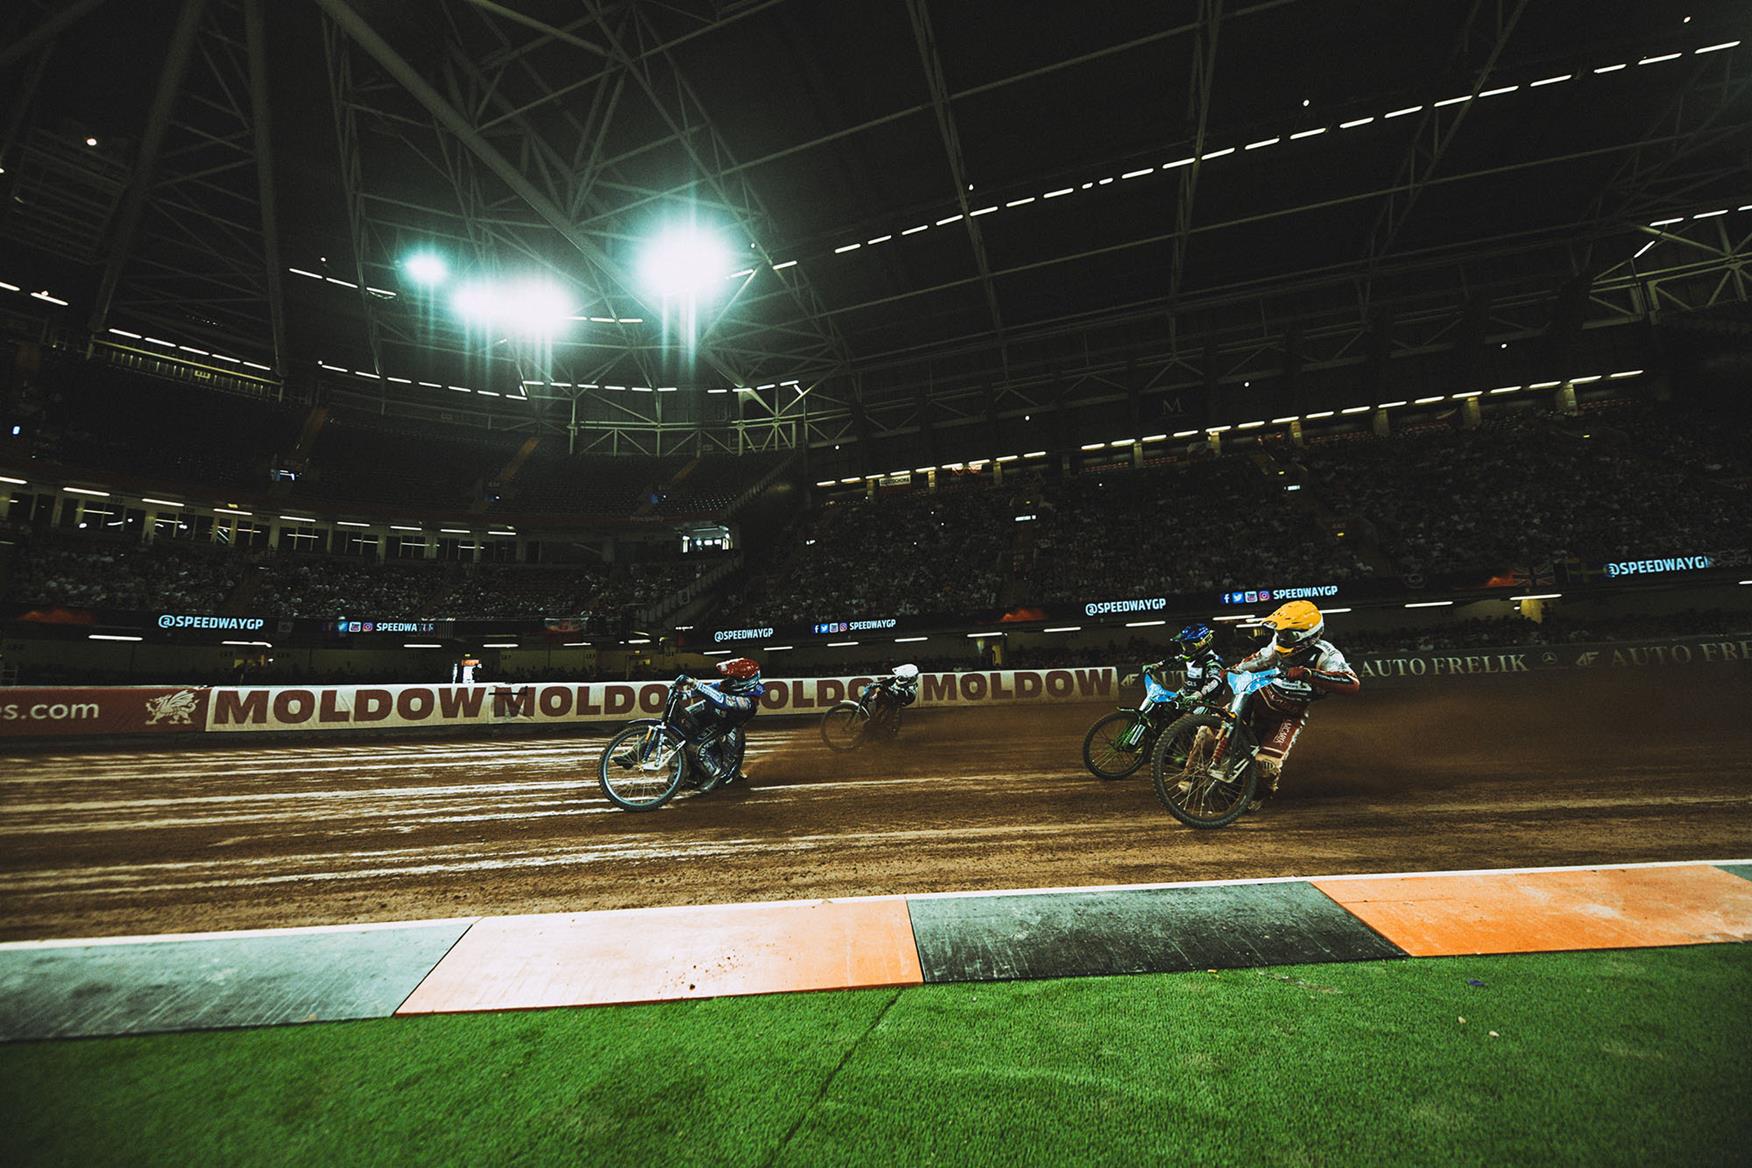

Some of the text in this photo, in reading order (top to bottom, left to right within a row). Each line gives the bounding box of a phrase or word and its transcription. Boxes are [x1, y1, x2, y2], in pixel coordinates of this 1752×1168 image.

[1161, 397, 1184, 416] M
[1272, 585, 1338, 600] SPEEDWAYGP
[1085, 598, 1166, 616] @SPEEDWAYGP
[158, 614, 264, 630] @SPEEDWAYGP
[849, 618, 896, 631] SPEEDWAYGP
[714, 627, 774, 642] @SPEEDWAYGP
[1611, 644, 1692, 667] AUTO
[1360, 657, 1426, 678] AUTO
[1431, 653, 1529, 675] FRELIK
[761, 677, 876, 710] OLDO
[922, 669, 1113, 702] MOLDOW
[213, 687, 487, 725] MOLDOW
[494, 683, 672, 718] MOLDO
[0, 703, 100, 720] s.com
